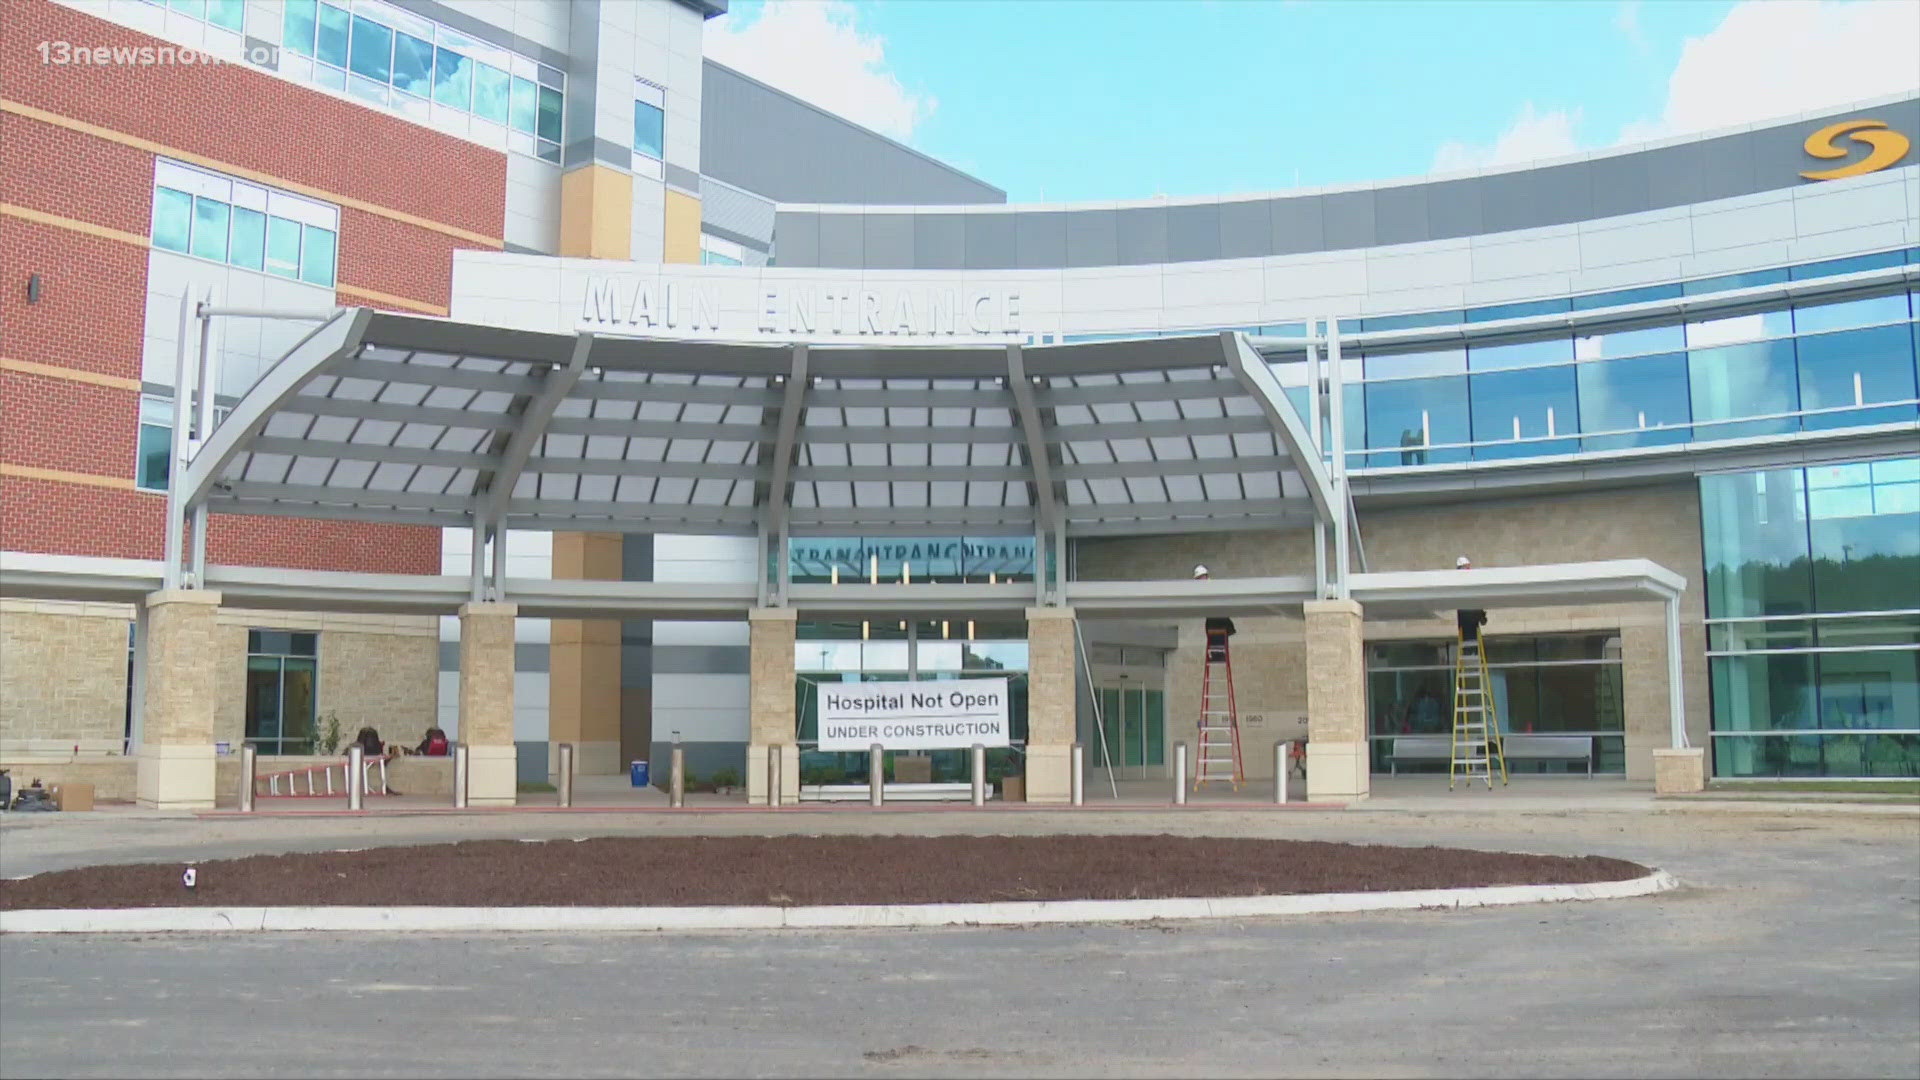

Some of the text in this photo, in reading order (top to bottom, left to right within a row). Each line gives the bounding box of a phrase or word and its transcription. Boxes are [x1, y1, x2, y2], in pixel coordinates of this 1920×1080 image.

[582, 275, 1022, 337] MAIN ENTRANCE
[827, 691, 999, 713] Hospital Not Open
[827, 721, 1001, 739] UNDER CONSTRUCTION
